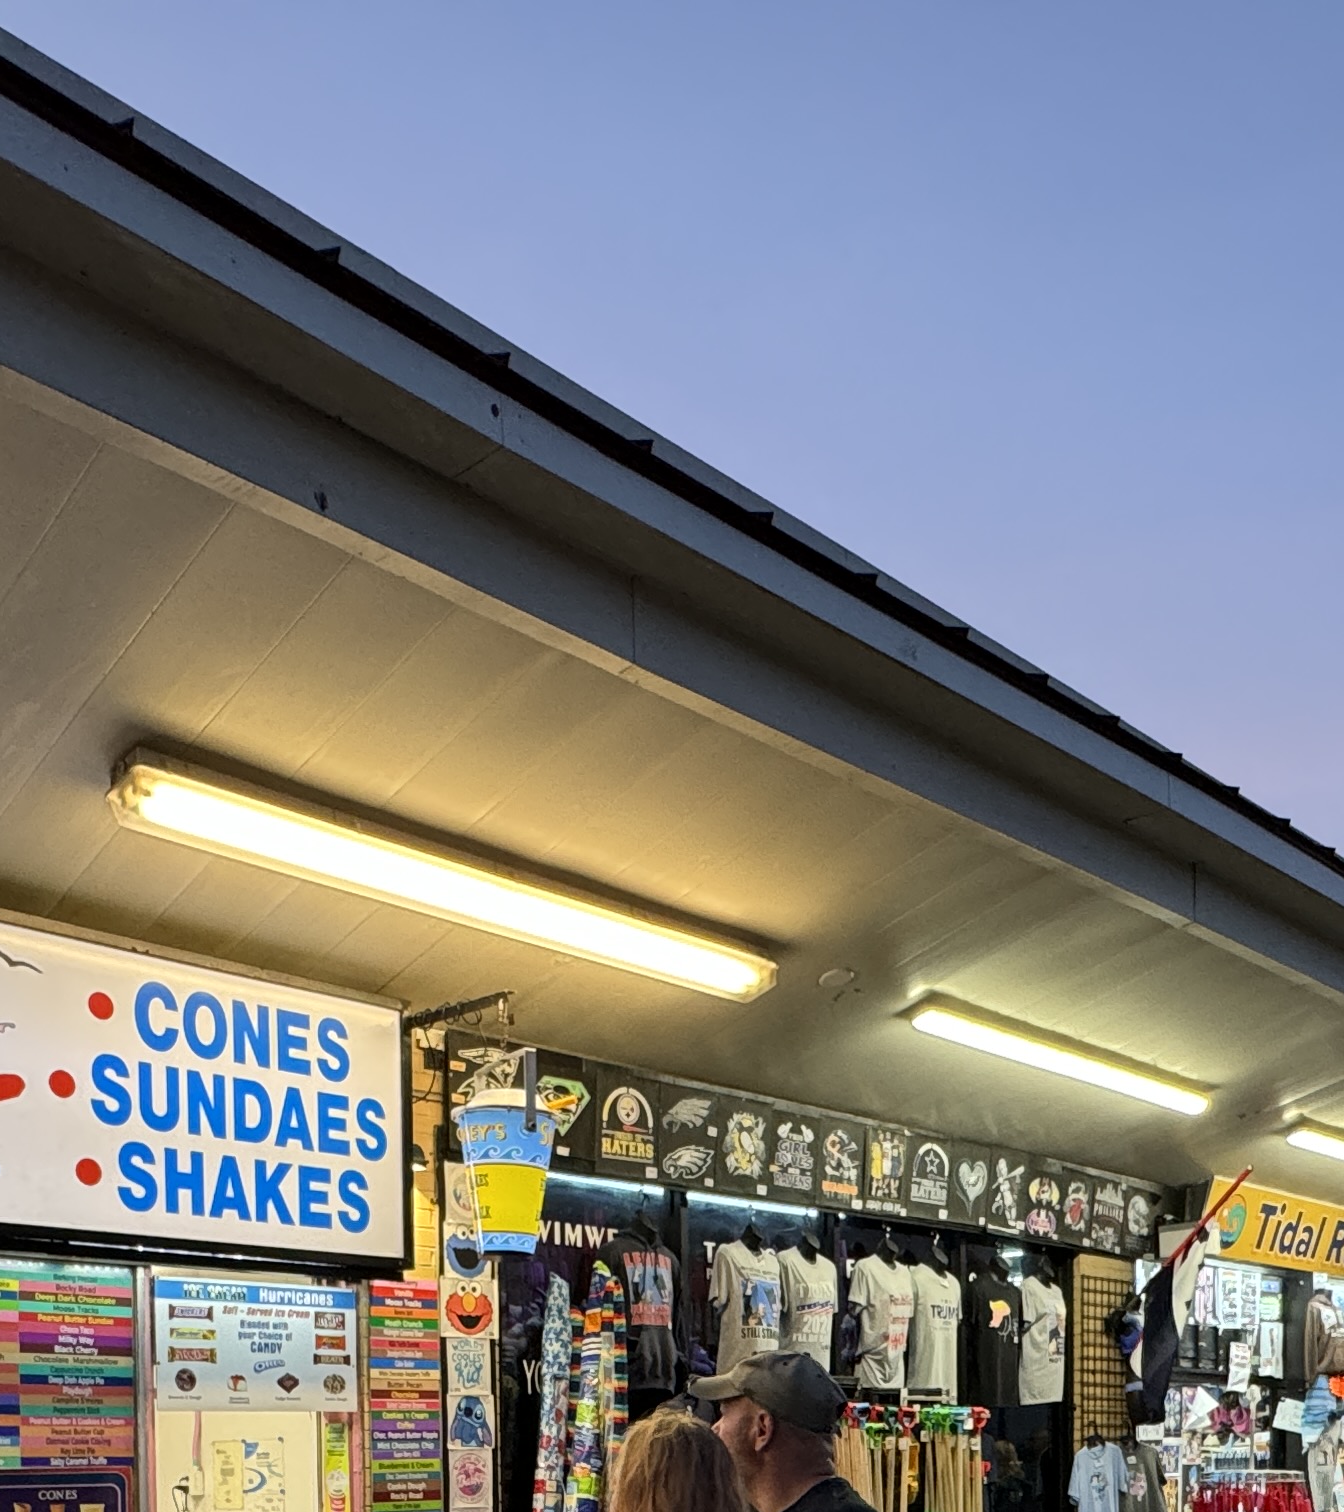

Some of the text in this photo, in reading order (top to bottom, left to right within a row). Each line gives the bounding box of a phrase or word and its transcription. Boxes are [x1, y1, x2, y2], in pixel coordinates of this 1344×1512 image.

[134, 981, 350, 1082] CONES
[90, 1054, 388, 1162] SUNDAES
[602, 1137, 654, 1158] HATERS
[777, 1139, 810, 1157] GIRL
[775, 1152, 814, 1169] LOVES
[116, 1142, 371, 1232] SHAKES
[773, 1172, 812, 1190] RAVENS
[1256, 1203, 1327, 1258] Tidal
[259, 1288, 333, 1306] Hurricanes
[251, 1341, 282, 1354] CANDY
[452, 1351, 486, 1362] COOLEST
[38, 1489, 78, 1500] CONES
